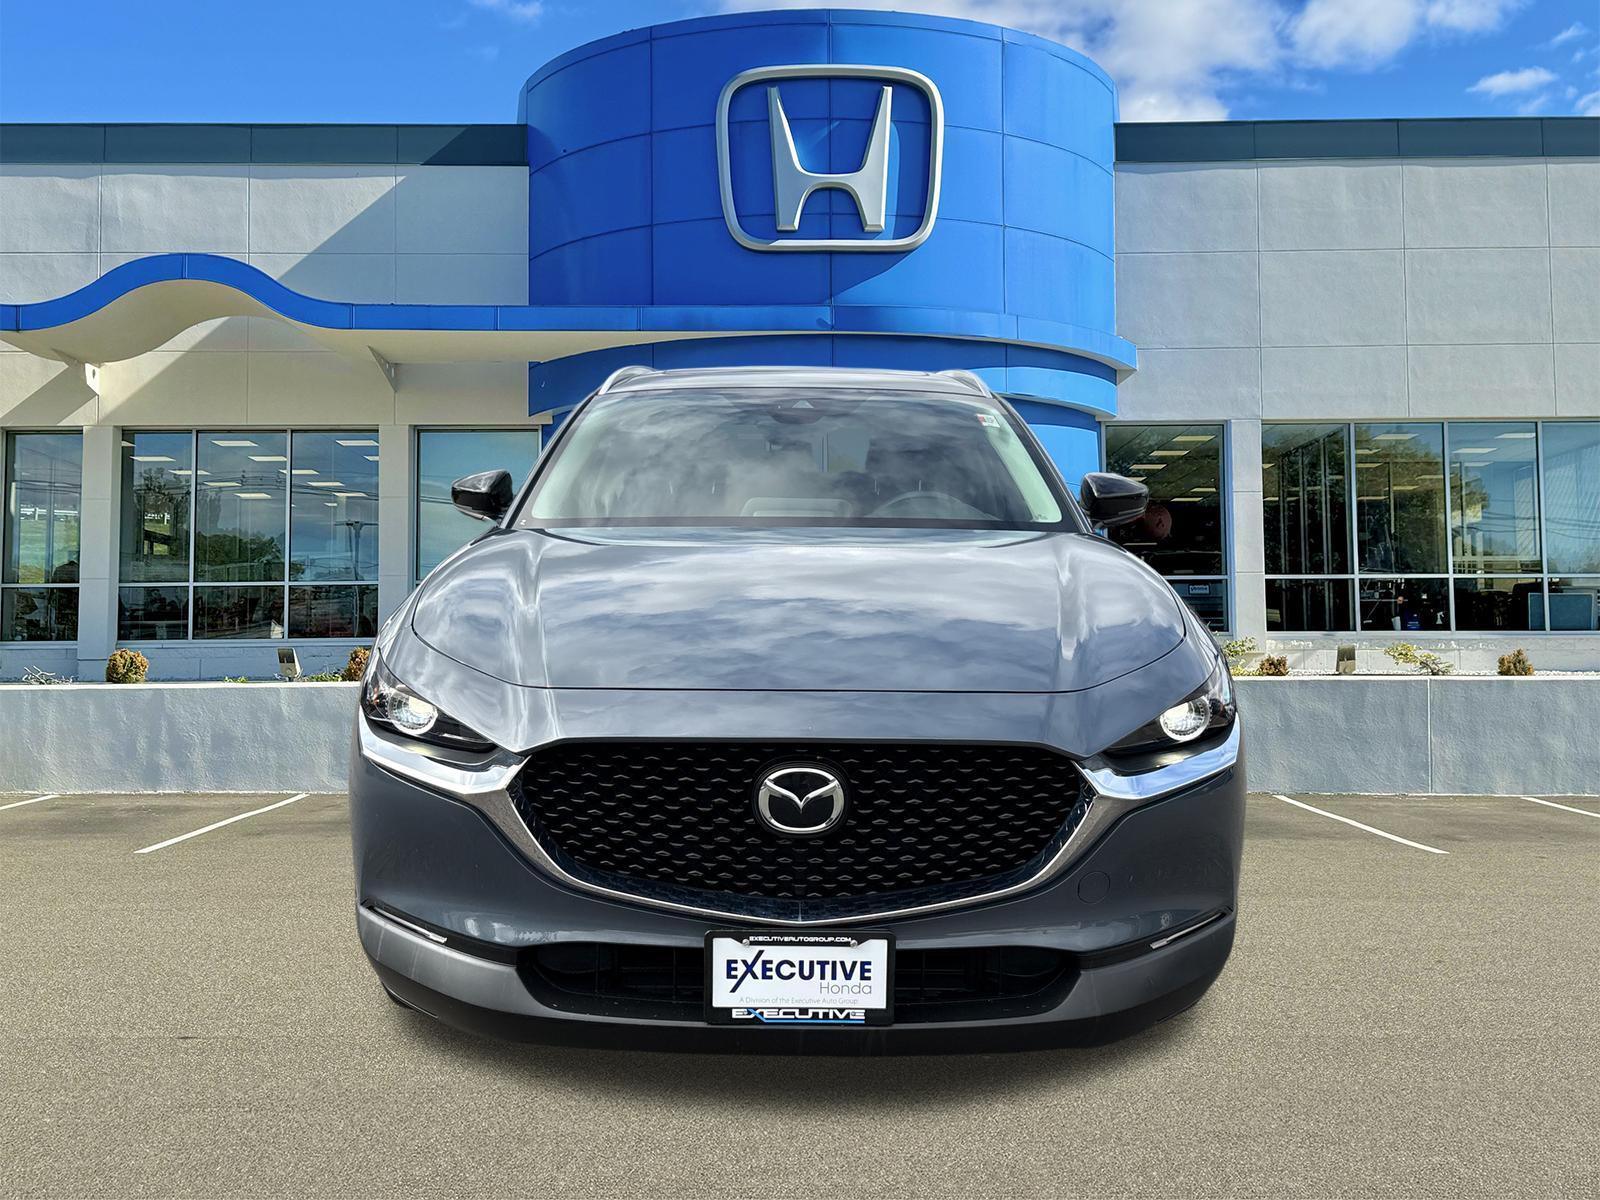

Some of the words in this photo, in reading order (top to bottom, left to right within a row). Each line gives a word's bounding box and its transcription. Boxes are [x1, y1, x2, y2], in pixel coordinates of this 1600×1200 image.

[726, 949, 872, 993] EXECUTIVE
[820, 982, 872, 994] Honda
[779, 997, 790, 1005] the
[791, 997, 821, 1005] Executive
[822, 997, 837, 1005] Auto
[839, 998, 858, 1006] Group
[732, 1008, 865, 1020] EXECUTIVE
